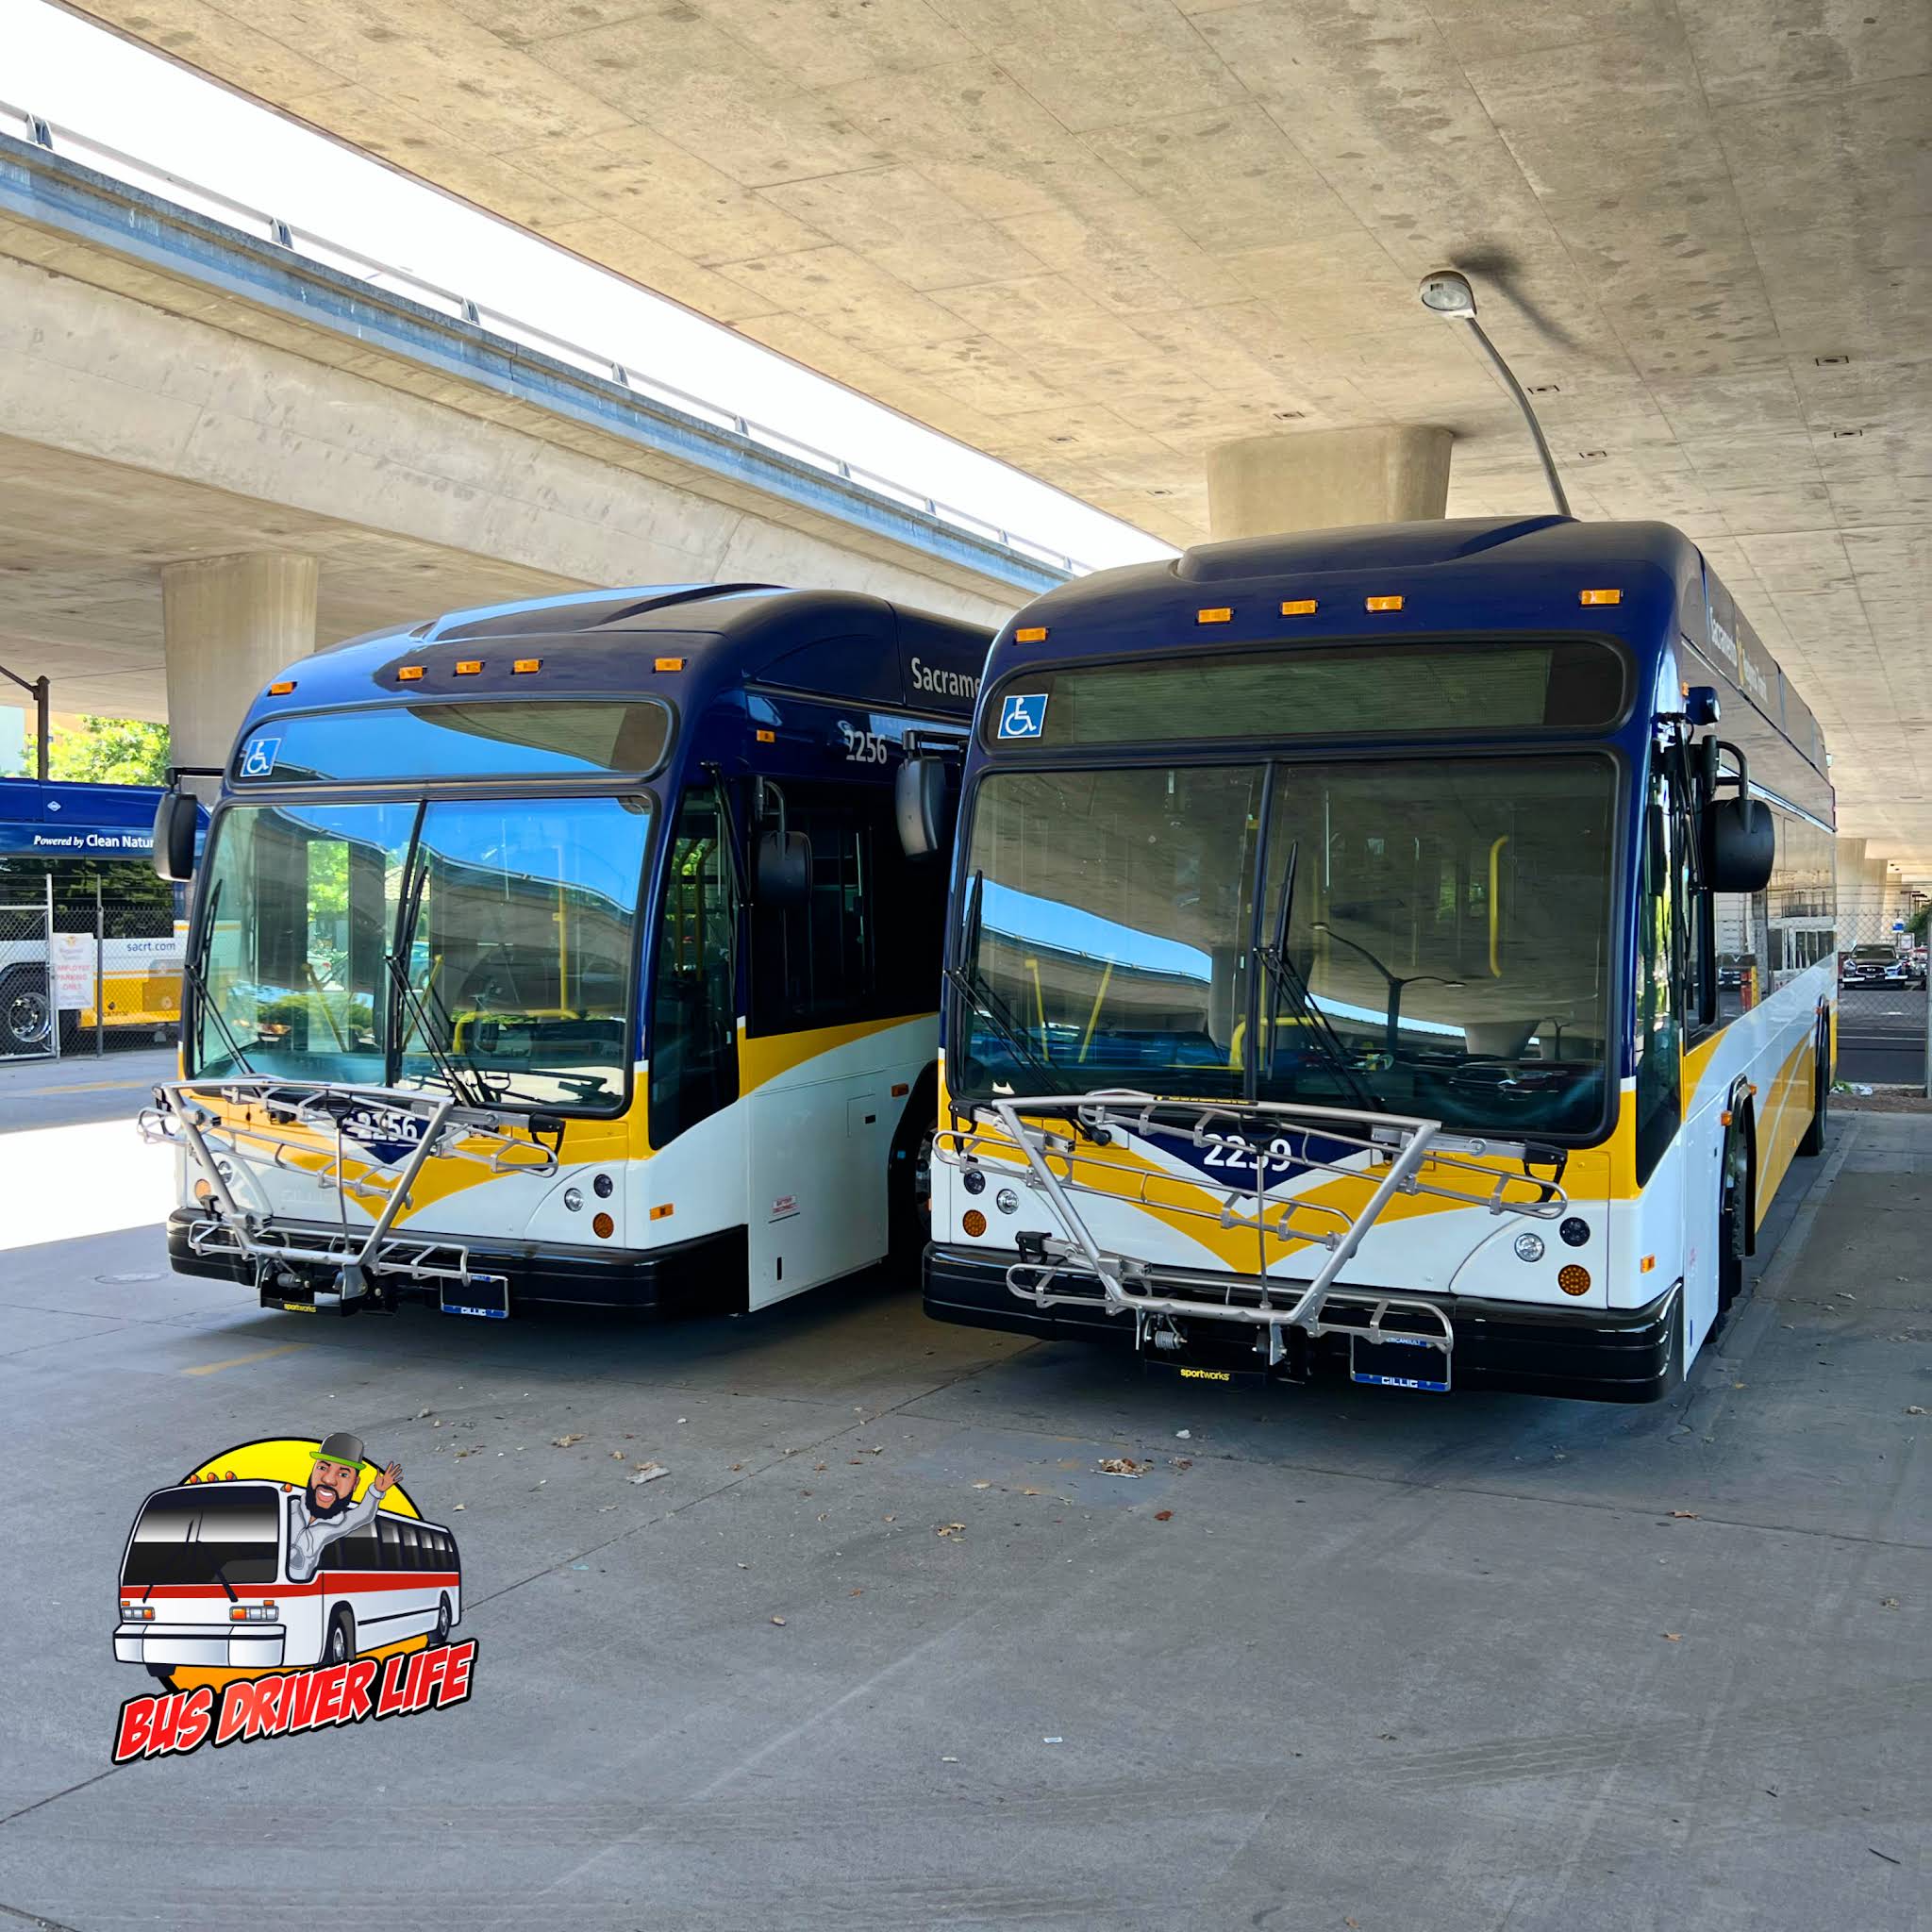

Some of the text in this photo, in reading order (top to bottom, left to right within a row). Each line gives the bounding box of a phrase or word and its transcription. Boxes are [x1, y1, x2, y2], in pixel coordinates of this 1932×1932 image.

[843, 729, 888, 765] 2256
[34, 835, 72, 846] Powered
[73, 837, 84, 848] by
[86, 835, 120, 848] Clean
[127, 942, 176, 952] sacrt.com
[1180, 1368, 1230, 1381] sportworks
[1381, 1375, 1419, 1389] GILLIG
